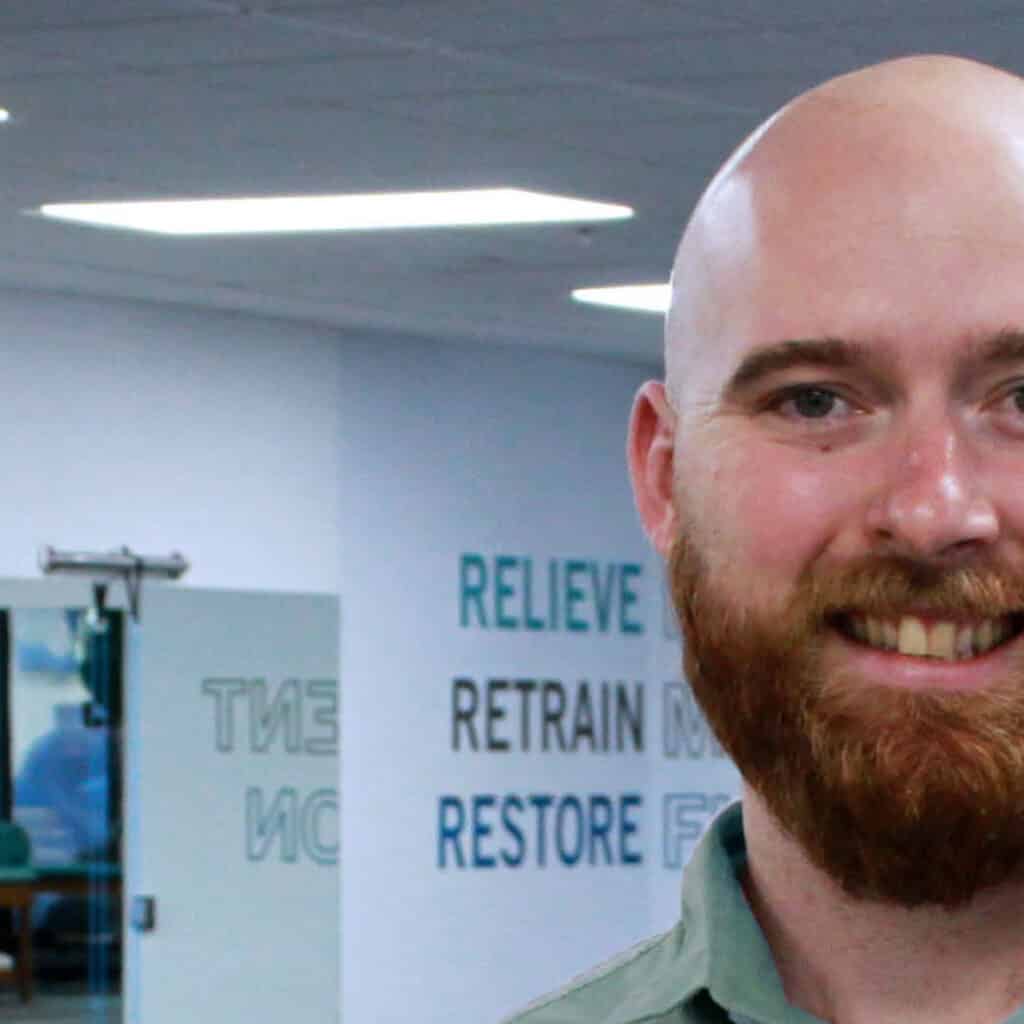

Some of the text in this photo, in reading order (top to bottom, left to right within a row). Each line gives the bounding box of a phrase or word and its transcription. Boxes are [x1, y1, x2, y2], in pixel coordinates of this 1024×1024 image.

[458, 553, 644, 634] RELIEVE
[452, 676, 644, 754] RETRAIN
[437, 793, 731, 869] RESTORE F
